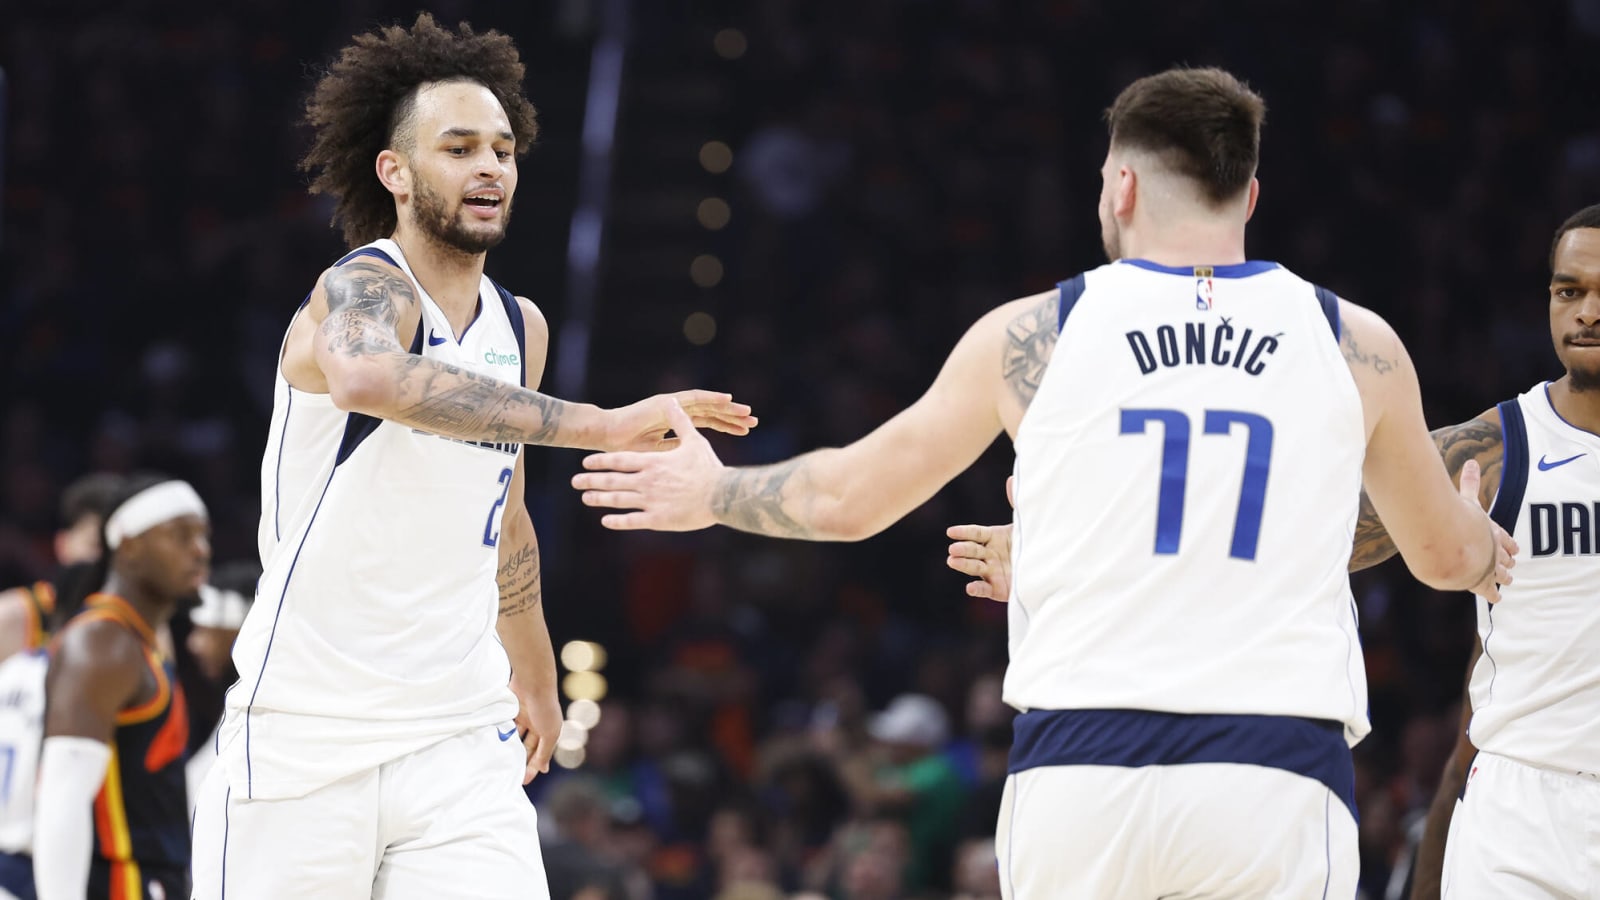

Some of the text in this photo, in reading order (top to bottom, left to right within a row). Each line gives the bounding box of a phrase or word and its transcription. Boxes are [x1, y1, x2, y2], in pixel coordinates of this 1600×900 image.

[484, 346, 519, 366] chime
[1126, 316, 1286, 376] DONČIĆ
[481, 466, 513, 548] 2
[1118, 408, 1275, 563] 77
[1529, 500, 1600, 558] DA
